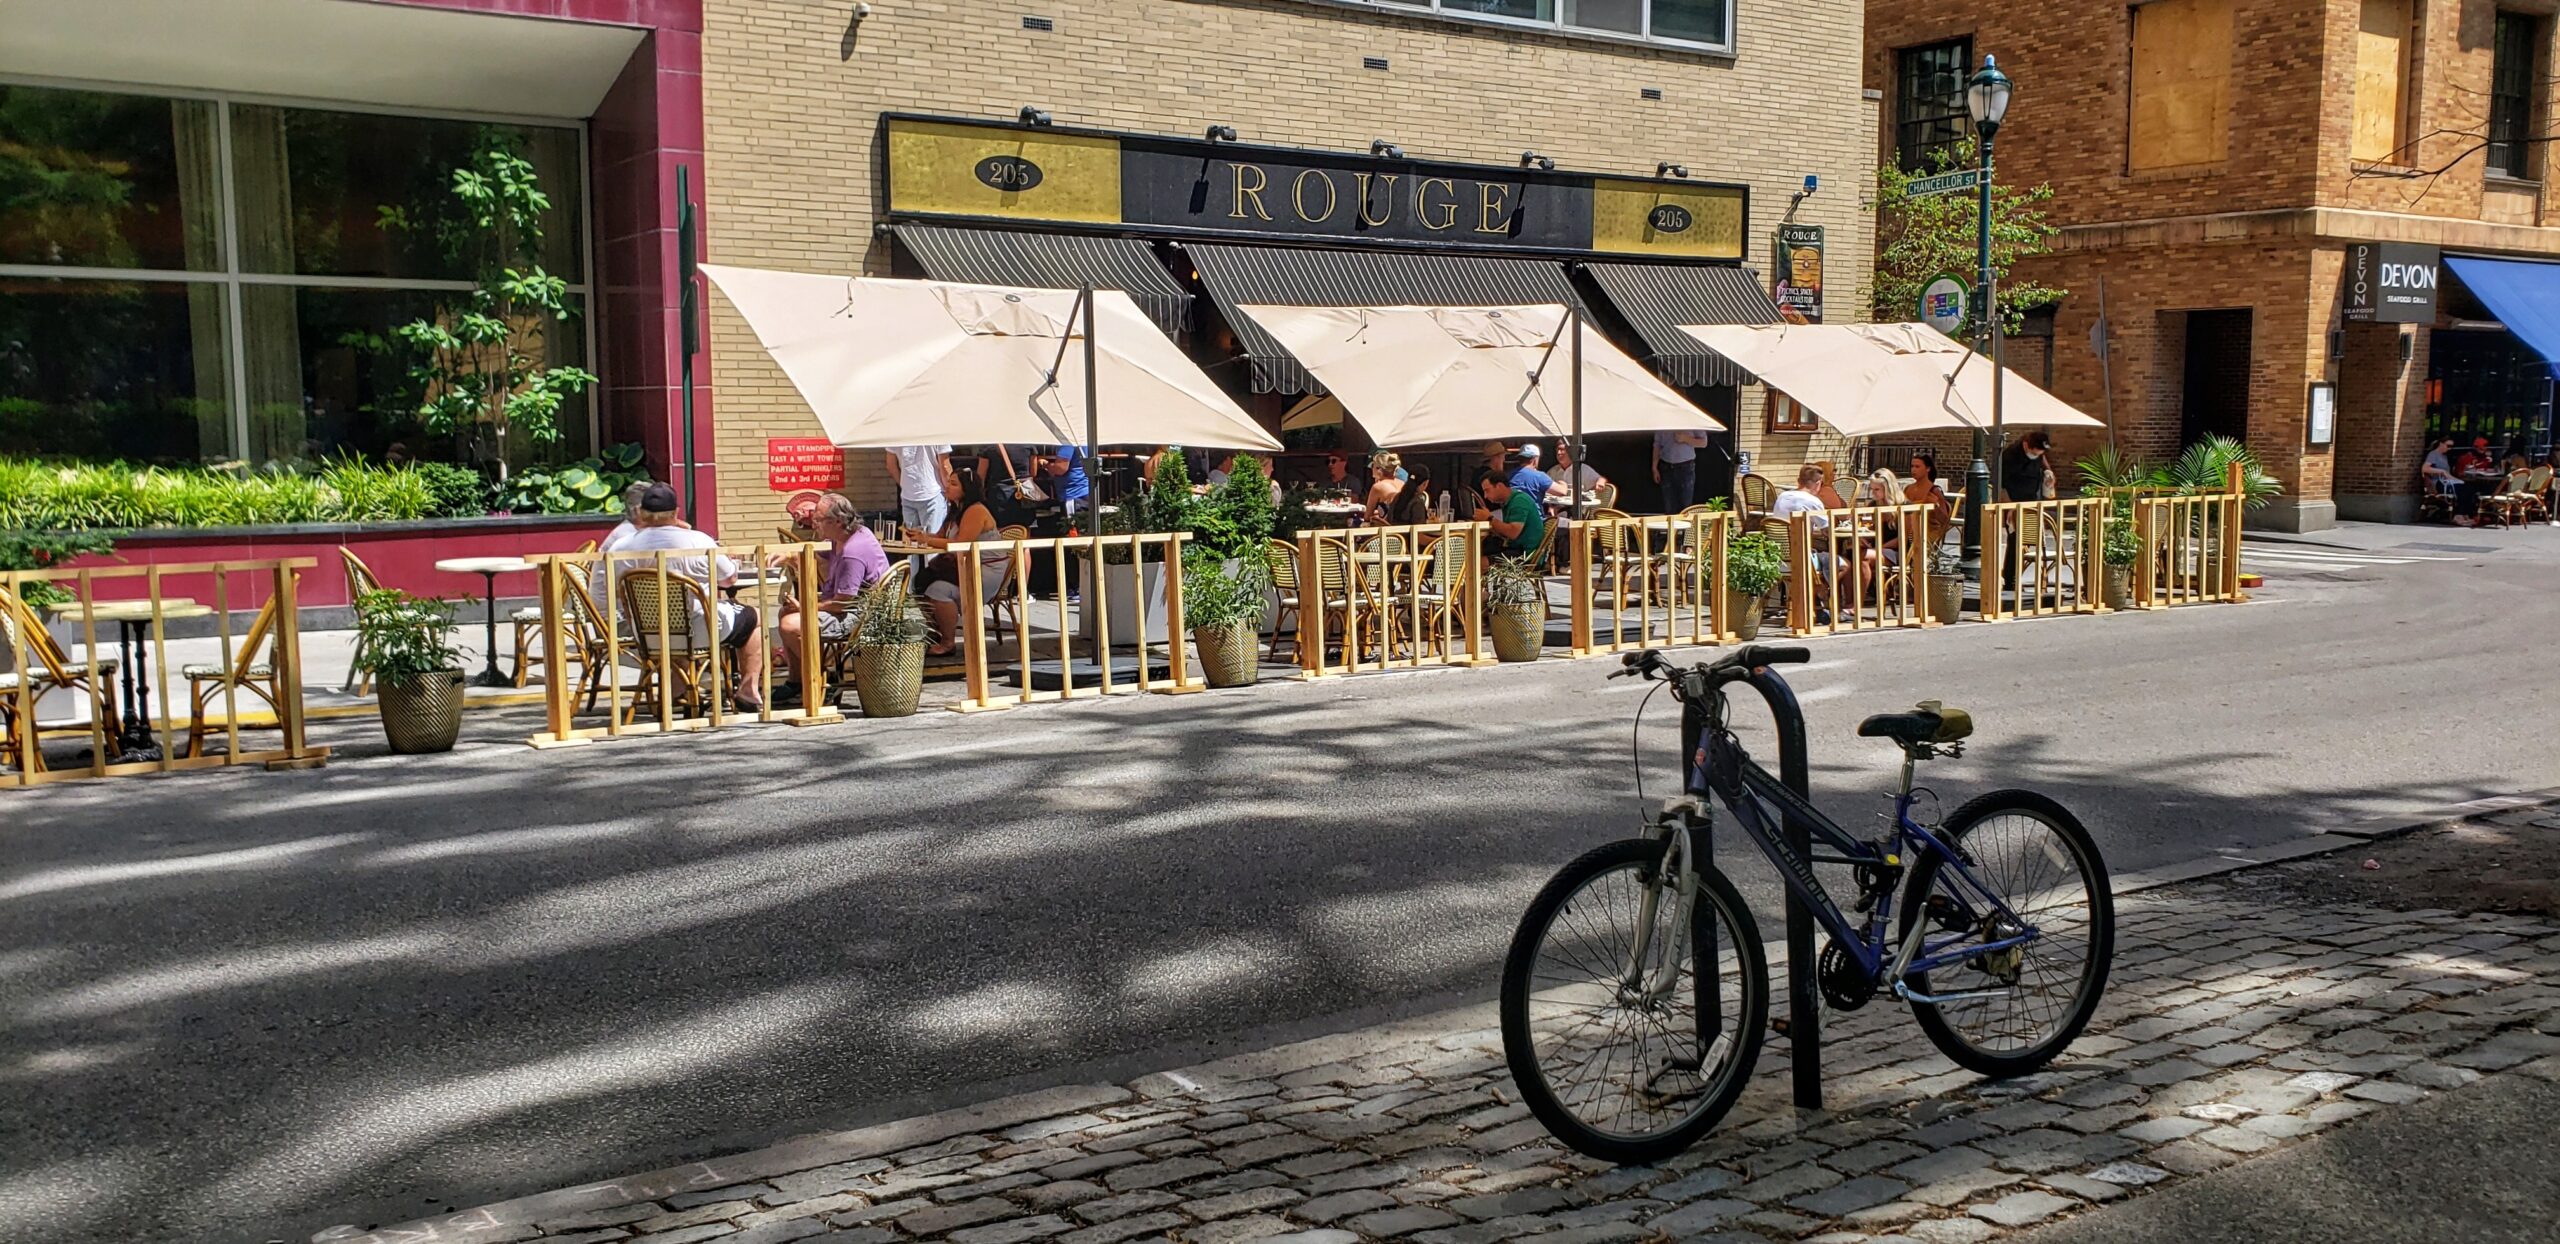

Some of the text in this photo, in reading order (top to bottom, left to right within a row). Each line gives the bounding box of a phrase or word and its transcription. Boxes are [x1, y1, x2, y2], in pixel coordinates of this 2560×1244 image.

[989, 162, 1029, 185] 205
[1908, 175, 1974, 194] CHANCELLOR ST
[1227, 163, 1512, 234] ROUGE
[1657, 210, 1684, 227] 205
[1783, 230, 1818, 240] ROUGE
[2354, 245, 2369, 306] DEVON
[2381, 263, 2437, 290] DEVON
[2387, 295, 2428, 304] SEAFOOD GRILL
[817, 454, 842, 462] TOWERS
[770, 465, 843, 473] PARTIAL SPRINKLERS
